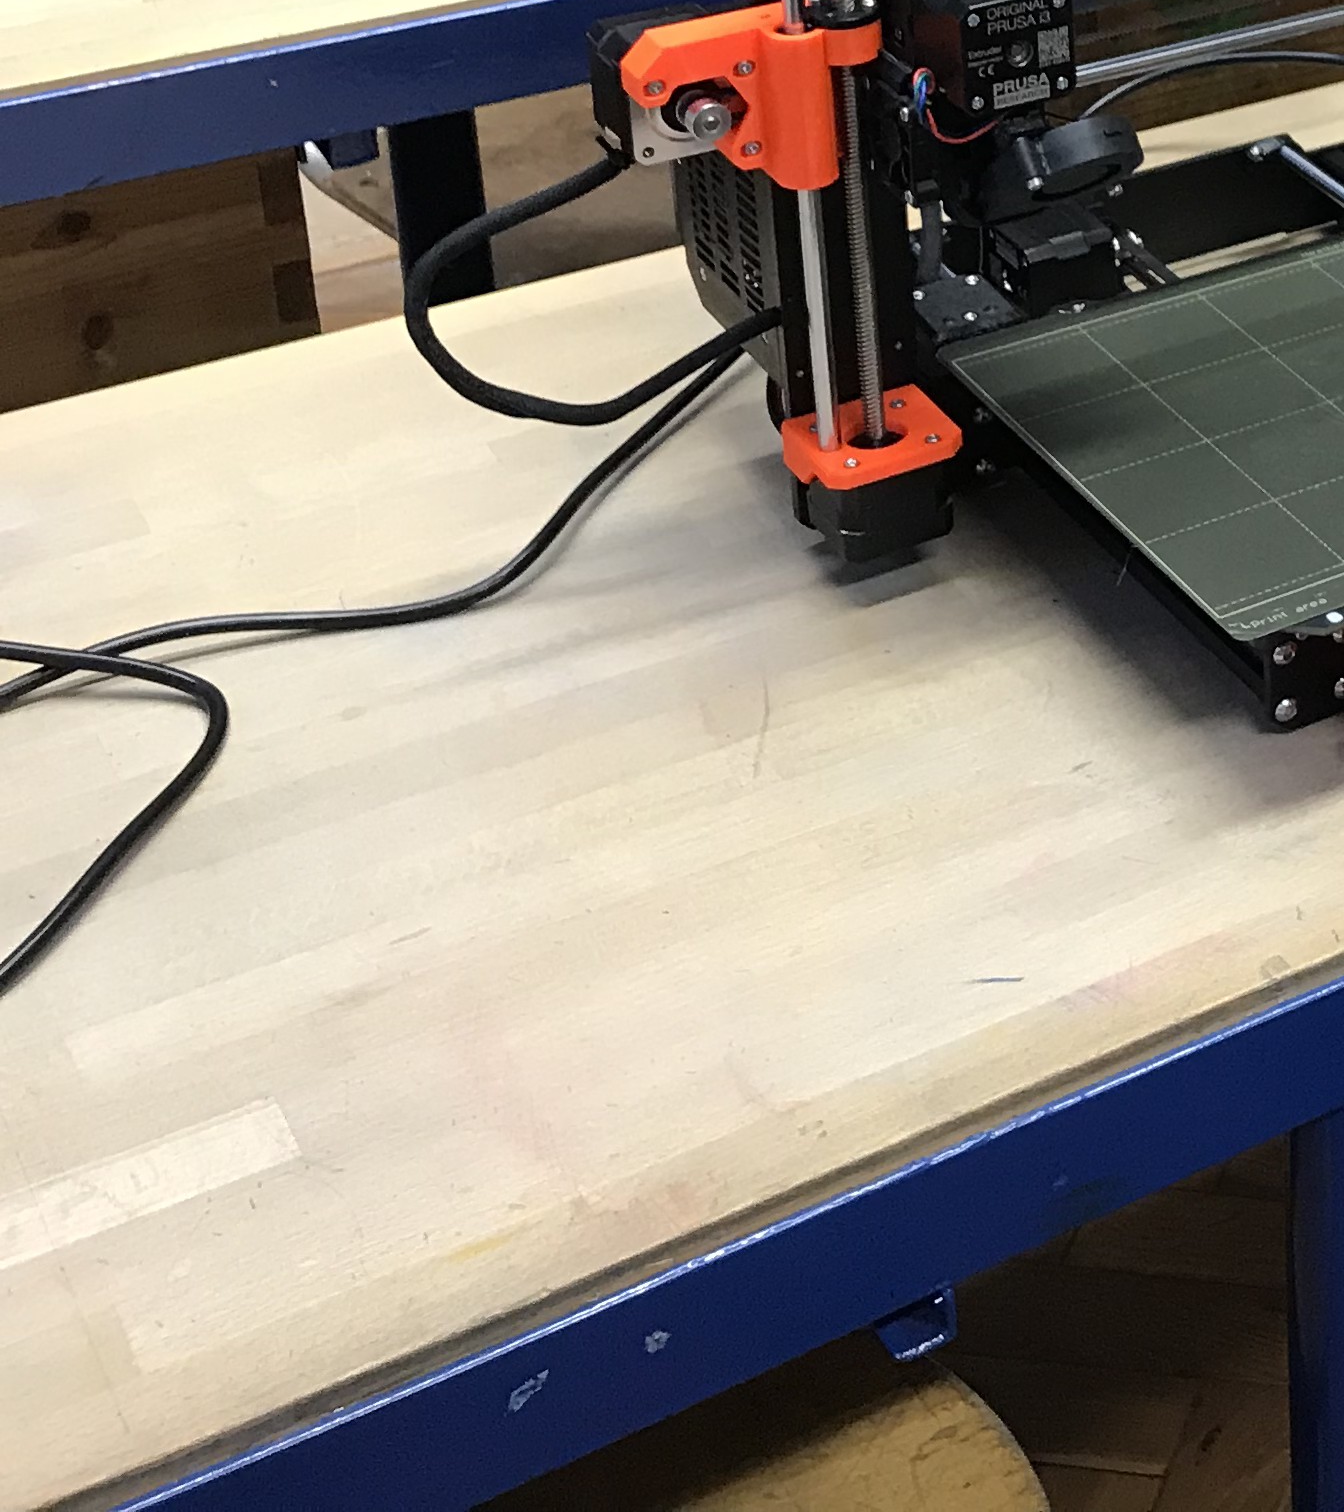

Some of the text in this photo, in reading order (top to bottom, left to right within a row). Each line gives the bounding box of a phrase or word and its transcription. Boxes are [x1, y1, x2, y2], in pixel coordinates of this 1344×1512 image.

[986, 14, 1037, 36] PRUSA
[992, 71, 1051, 97] PRUSA
[1249, 597, 1328, 629] print area
